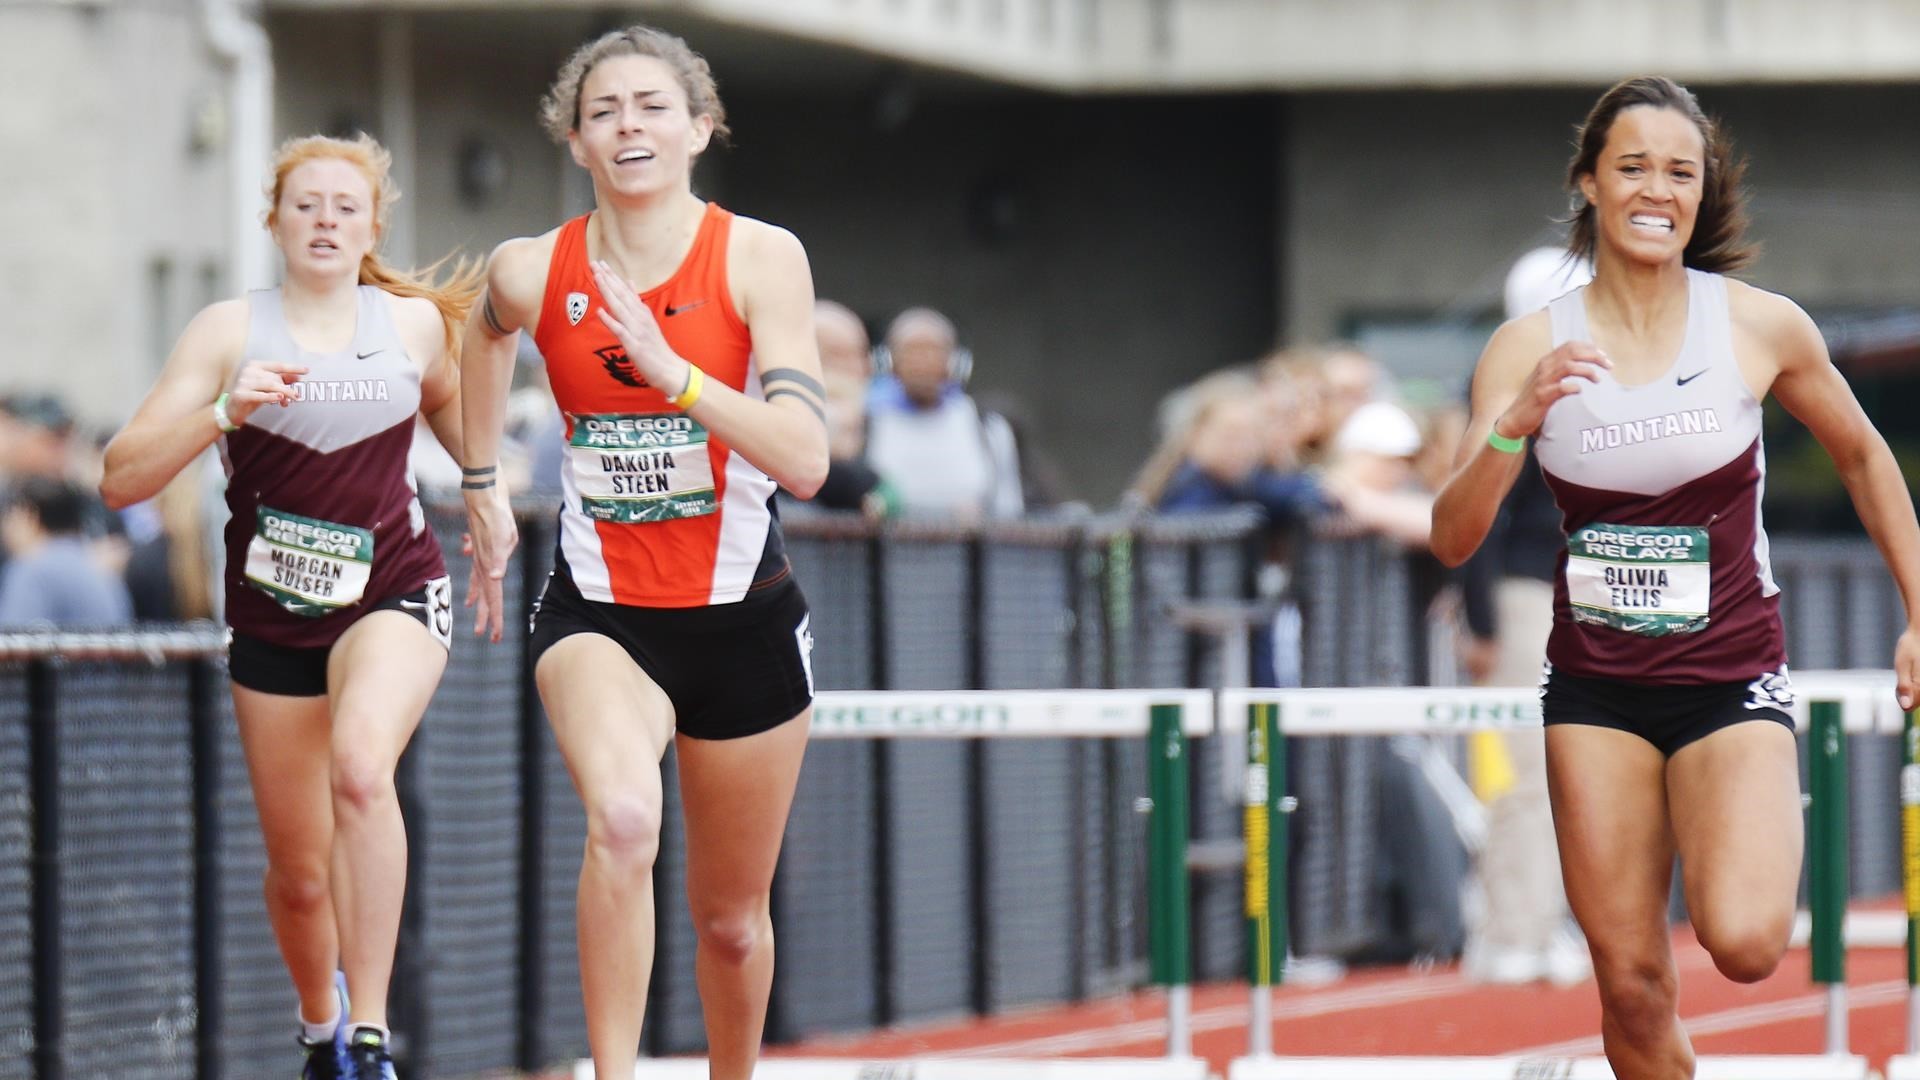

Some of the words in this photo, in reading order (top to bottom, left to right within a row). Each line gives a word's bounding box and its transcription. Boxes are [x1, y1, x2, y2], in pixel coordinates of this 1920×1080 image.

[281, 380, 390, 402] ONTANA
[586, 417, 693, 433] OREGON
[1580, 407, 1722, 454] MONTANA
[587, 430, 690, 446] RELAYS
[600, 452, 676, 473] DAKOTA
[612, 473, 670, 495] STEEN
[264, 515, 362, 548] OREGON
[264, 527, 358, 558] RELAYS
[1583, 529, 1693, 548] OREGON
[1585, 541, 1690, 560] RELAYS
[271, 548, 343, 580] MORGAN
[273, 566, 335, 598] SULSER
[1604, 566, 1669, 588] OLIVIA
[1610, 586, 1662, 609] ELLIS
[813, 702, 1009, 730] REGON
[1425, 702, 1542, 724] ORE
